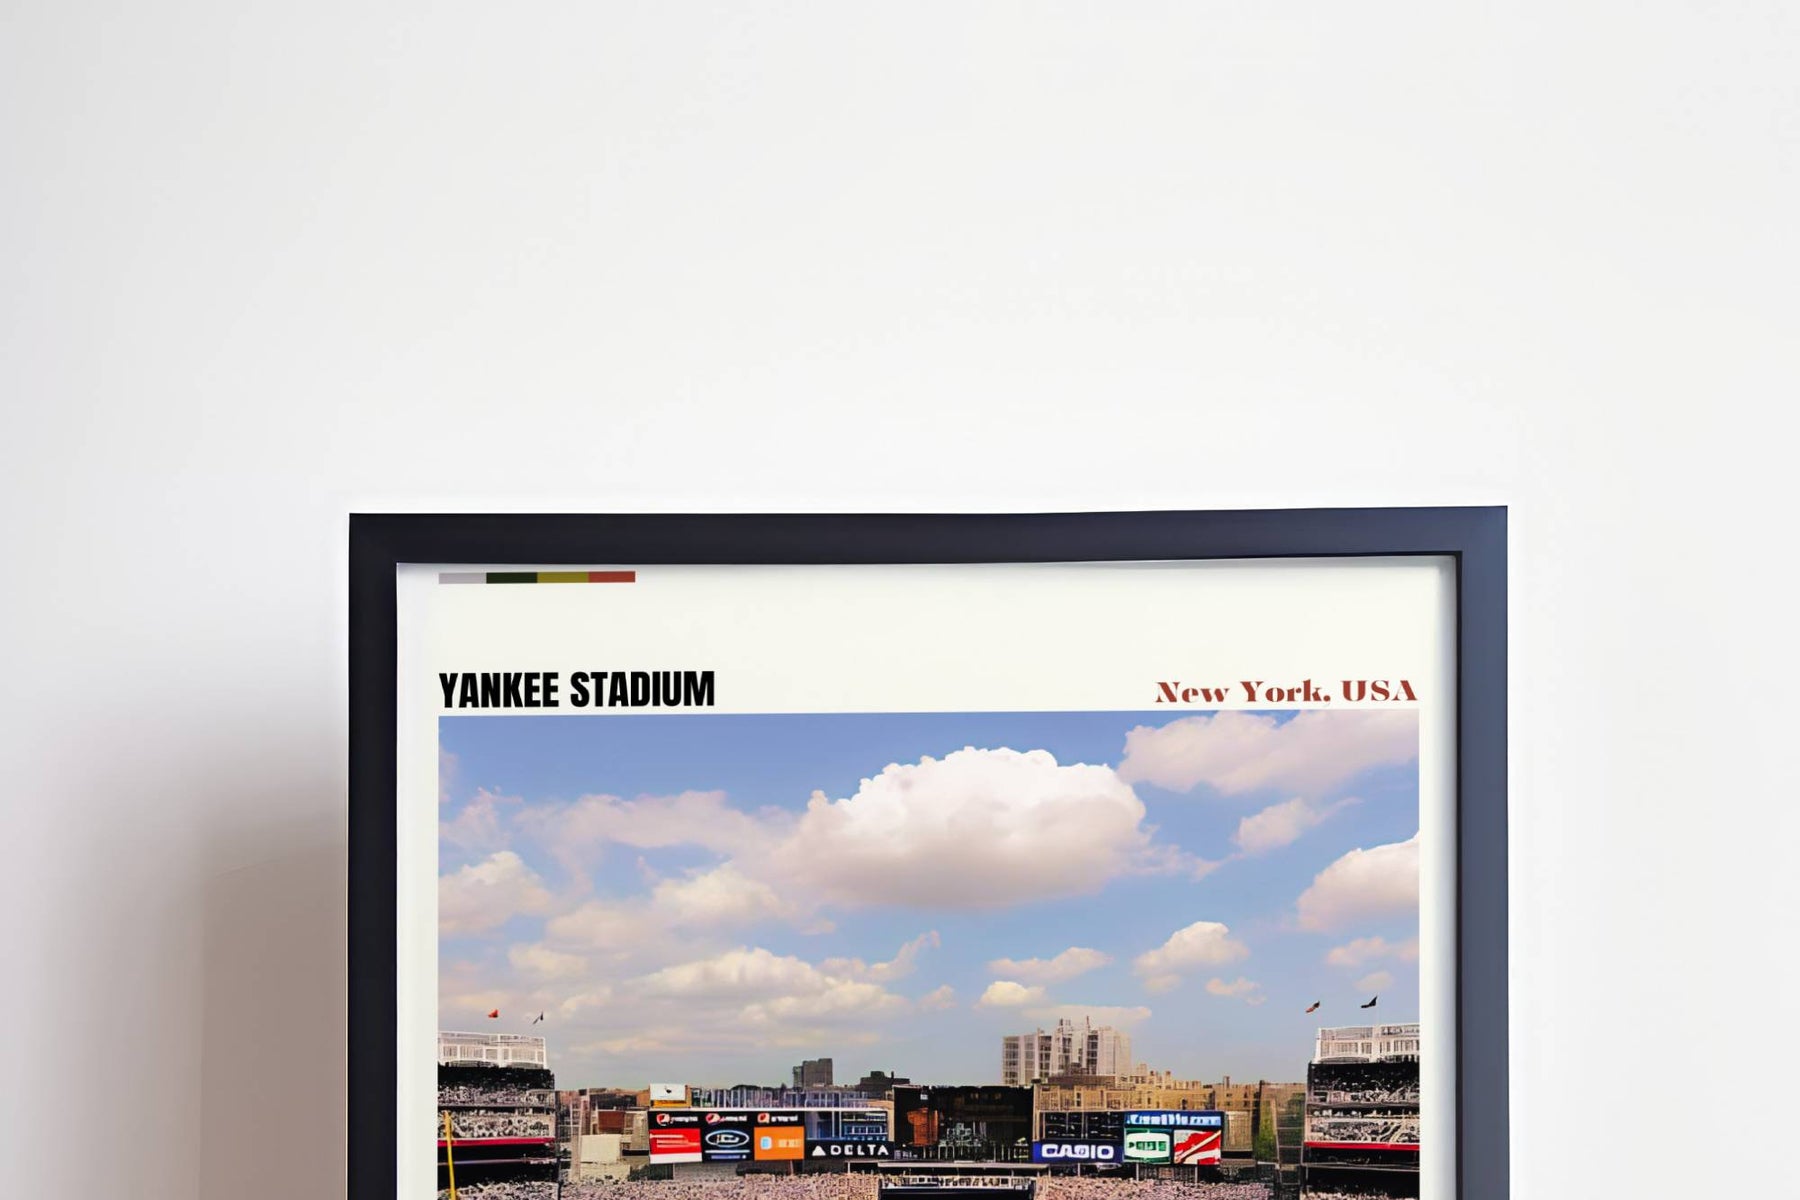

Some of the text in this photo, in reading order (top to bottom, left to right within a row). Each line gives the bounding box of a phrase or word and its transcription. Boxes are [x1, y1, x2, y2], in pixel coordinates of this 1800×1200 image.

[439, 671, 715, 708] YANKEE STADIUM
[1155, 681, 1230, 703] New
[1342, 680, 1418, 701] USA
[830, 1144, 889, 1157] DELTA
